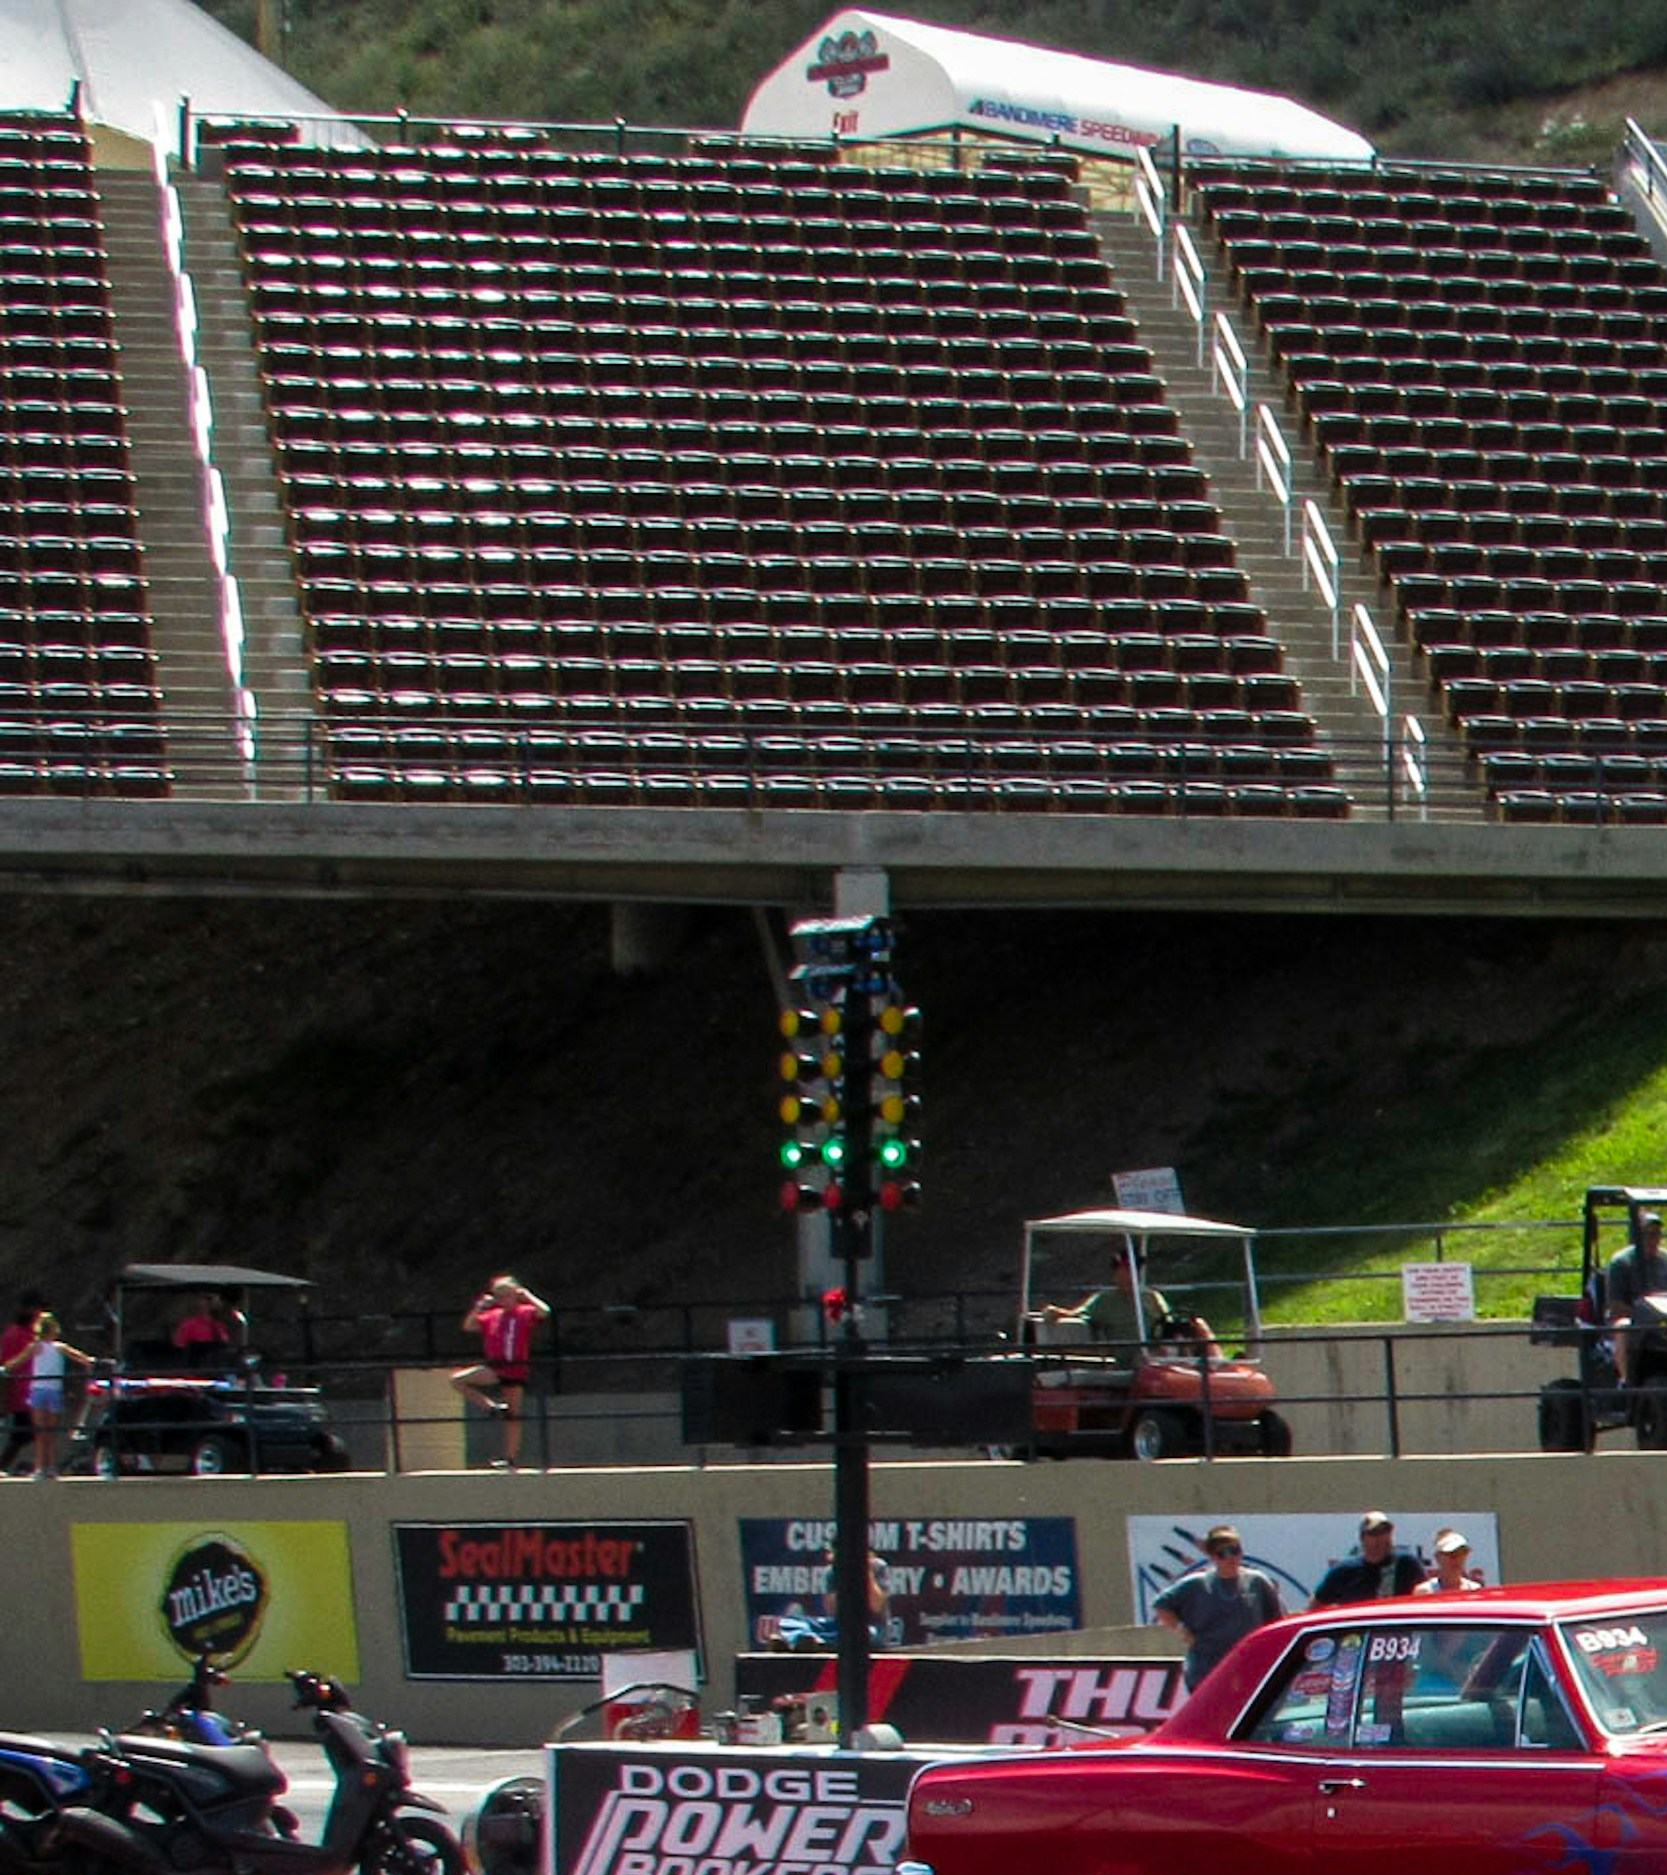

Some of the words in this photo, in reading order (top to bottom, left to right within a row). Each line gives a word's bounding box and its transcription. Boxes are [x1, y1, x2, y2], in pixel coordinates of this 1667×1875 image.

[983, 101, 1078, 133] BANDIMERE
[787, 1522, 898, 1551] CUSM
[907, 1521, 1026, 1551] T-SHIRTS
[438, 1529, 636, 1578] SealMaster
[169, 1564, 257, 1628] mike's
[754, 1566, 924, 1595] EMBRRY
[951, 1566, 1072, 1596] AWARDS
[1370, 1637, 1422, 1661] B934
[1576, 1627, 1648, 1652] B934
[620, 1765, 860, 1801] DODGE
